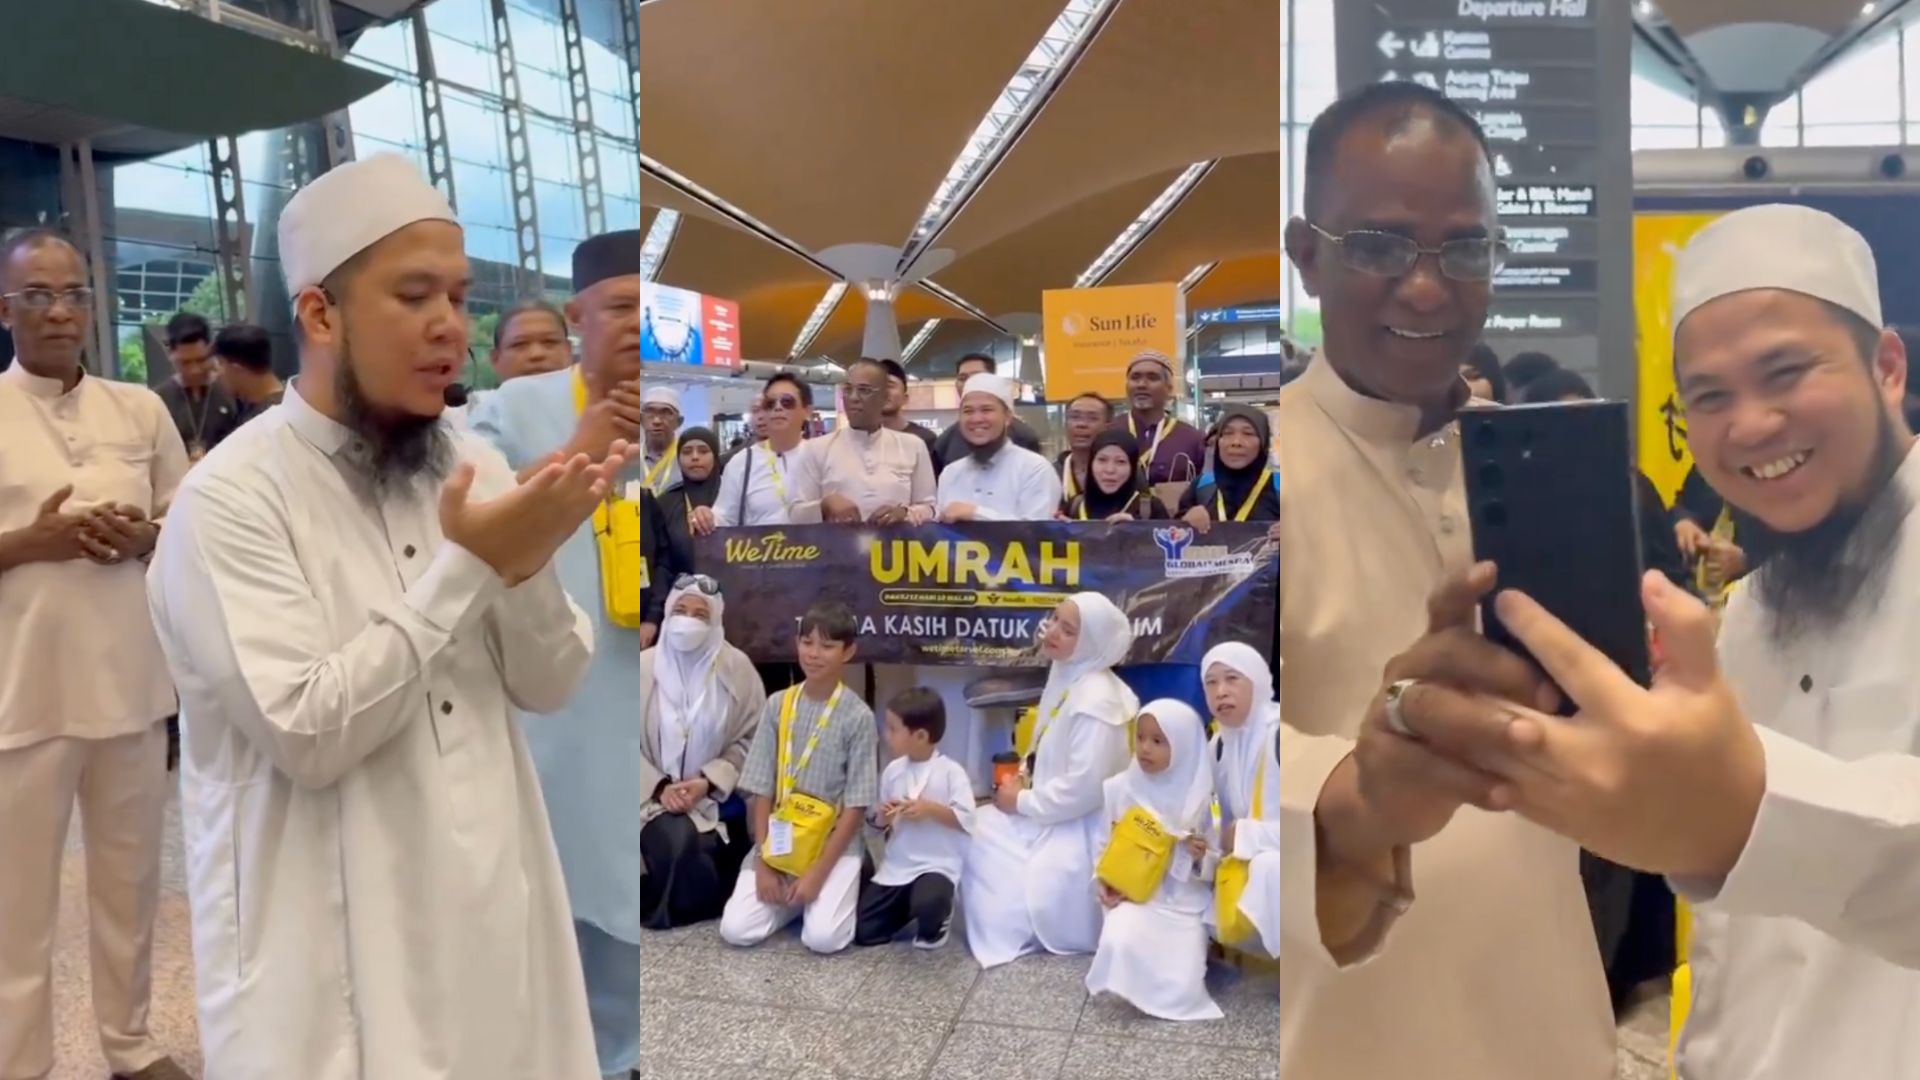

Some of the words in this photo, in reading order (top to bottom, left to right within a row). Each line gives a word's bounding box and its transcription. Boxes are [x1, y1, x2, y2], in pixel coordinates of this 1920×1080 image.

[1458, 0, 1546, 21] Departure
[1550, 0, 1588, 17] Hall
[1089, 316, 1122, 331] Sun
[1126, 312, 1157, 331] Life
[725, 531, 820, 563] WeTime
[870, 540, 1080, 585] UMRAH
[884, 615, 947, 637] KASIH
[955, 617, 1030, 638] DATUK
